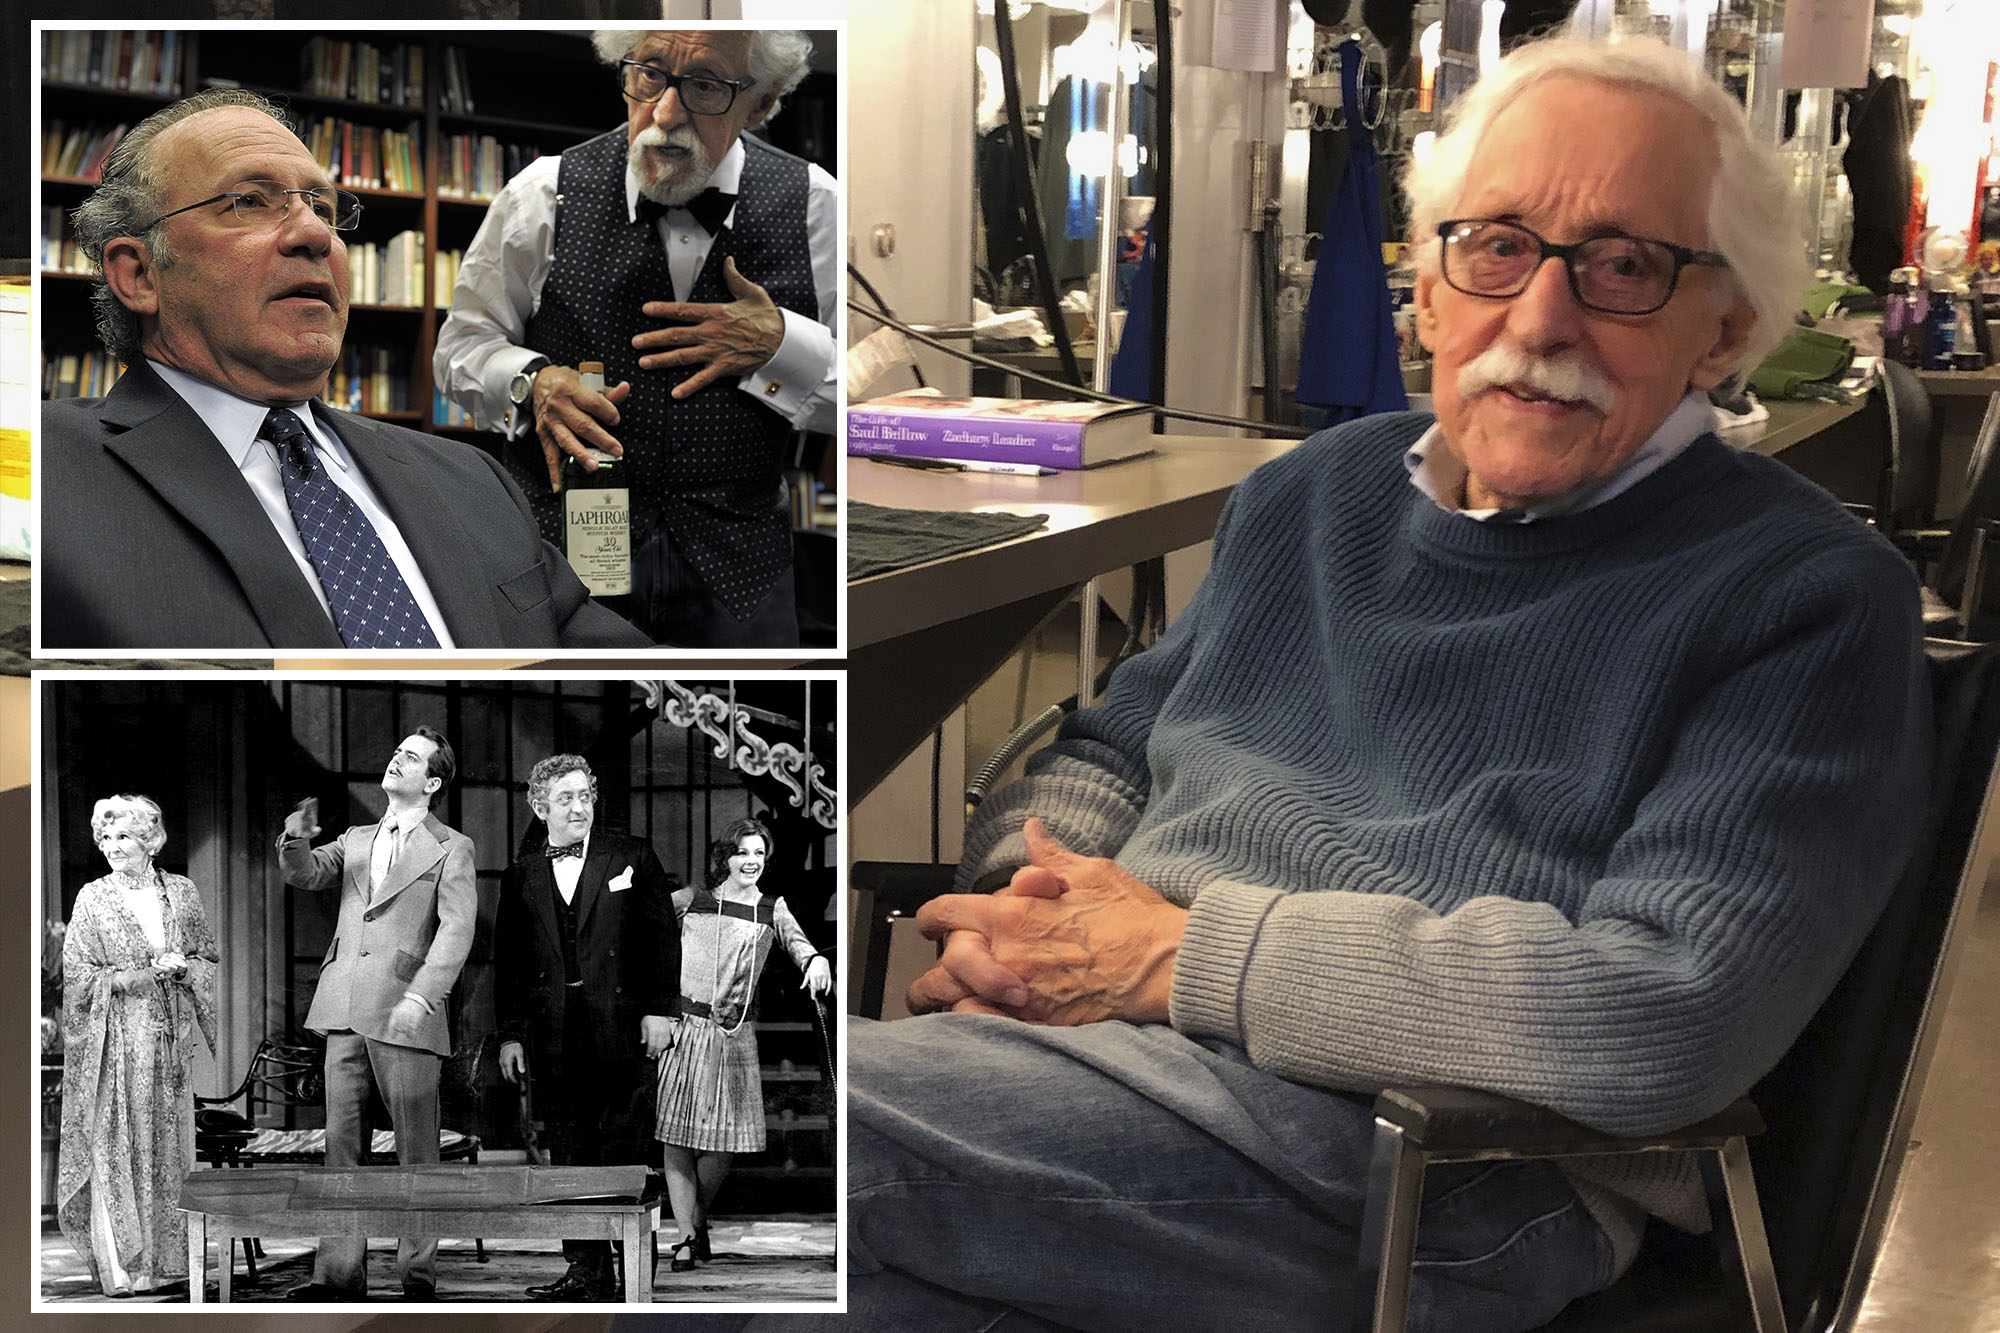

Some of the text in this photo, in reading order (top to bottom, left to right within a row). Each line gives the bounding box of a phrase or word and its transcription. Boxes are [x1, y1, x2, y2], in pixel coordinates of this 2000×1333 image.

[849, 424, 928, 441] Saul Bellow
[603, 536, 617, 547] 10
